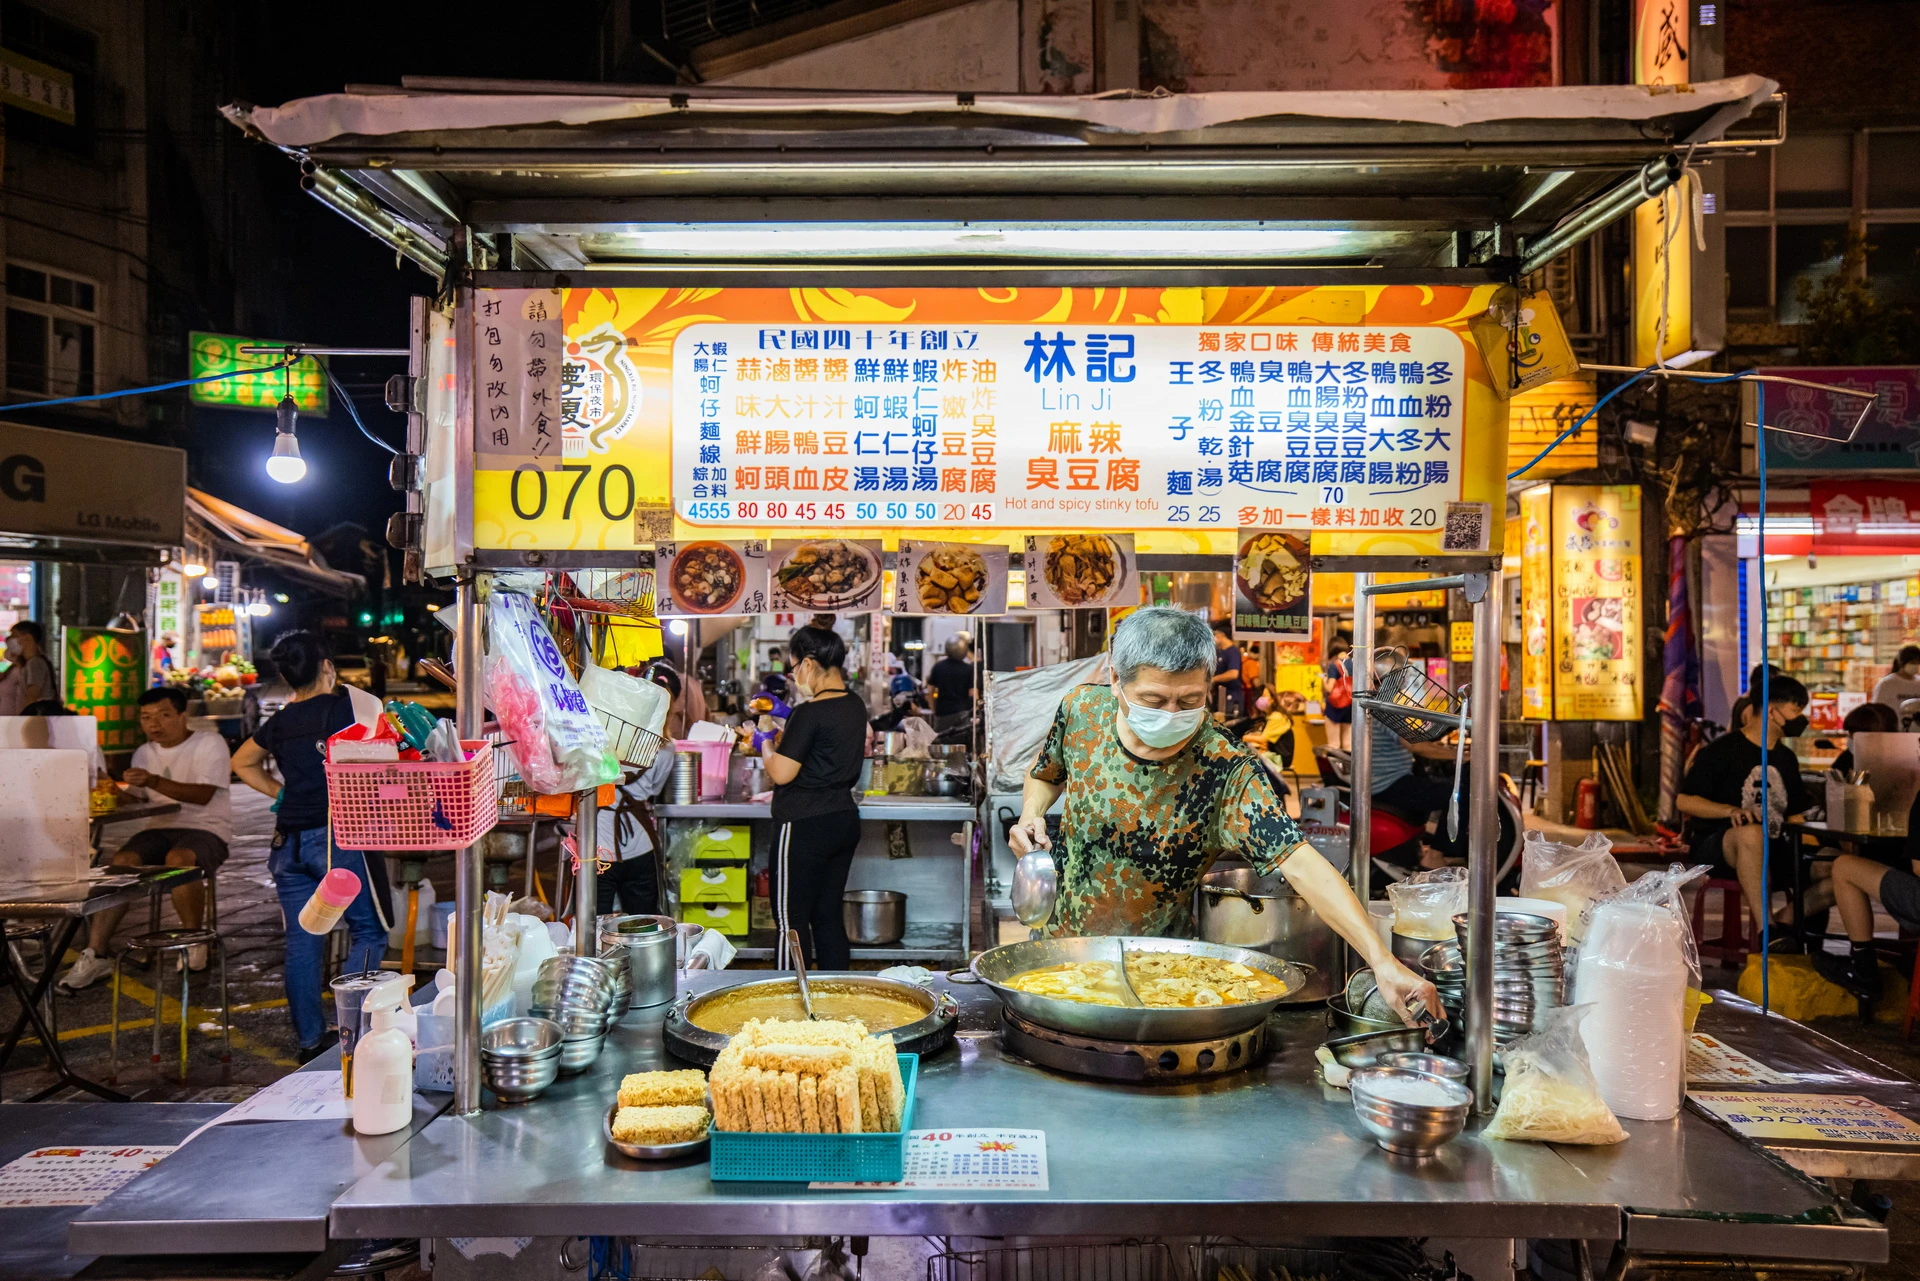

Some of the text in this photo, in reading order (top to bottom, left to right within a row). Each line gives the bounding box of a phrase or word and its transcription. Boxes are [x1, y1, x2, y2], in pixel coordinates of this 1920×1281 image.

[589, 372, 602, 417] 環保夜市
[758, 329, 980, 350] 民國四十年創立
[1023, 331, 1137, 384] 林記
[1042, 388, 1111, 410] Lin Ji
[1198, 332, 1412, 353] 獨家口味 傳統美食
[735, 357, 762, 491] 蒜味鮮蚵
[764, 357, 791, 491] 滷大腸頭
[793, 357, 820, 491] 醬汁鴨血
[822, 357, 849, 492] 醬汁豆皮
[853, 358, 880, 491] 鮮蚵仁湯
[882, 358, 910, 491] 鮮蝦仁湯
[911, 358, 939, 492] 蝦仁蚵仔湯
[941, 359, 968, 493] 炸嫩豆腐
[970, 359, 997, 494] 油炸臭豆腐
[1026, 457, 1140, 492] 臭豆腐
[1047, 420, 1122, 455] 麻辣
[1166, 361, 1195, 496] 王子麵
[1228, 361, 1256, 484] 鴨血金針菇
[1256, 361, 1283, 484] 臭豆腐
[1284, 361, 1313, 484] 鴨血臭豆腐
[1312, 361, 1342, 484] 大腸臭豆腐
[1340, 361, 1369, 484] 冬粉臭豆腐
[1368, 361, 1397, 484] 鴨血大腸
[1395, 361, 1424, 485] 鴨血冬粉
[1423, 362, 1453, 485] 冬粉大腸
[77, 512, 162, 533] LG Mobile
[511, 463, 635, 521] 070
[737, 502, 758, 519] 80
[766, 502, 787, 519] 80
[795, 502, 816, 520] 45
[824, 503, 845, 520] 45
[856, 503, 877, 519] 50
[886, 503, 907, 519] 50
[915, 503, 936, 520] 50
[943, 504, 965, 521] 20
[971, 503, 992, 520] 45
[1167, 506, 1190, 522] 25
[1198, 506, 1221, 522] 25
[1005, 497, 1159, 514] Hot and spicy stinky tofu
[1237, 507, 1436, 526] 多加一樣料加收 20
[1323, 487, 1344, 504] 70
[1823, 494, 1920, 533] 金牌
[897, 544, 912, 613] 油炸臭豆腐
